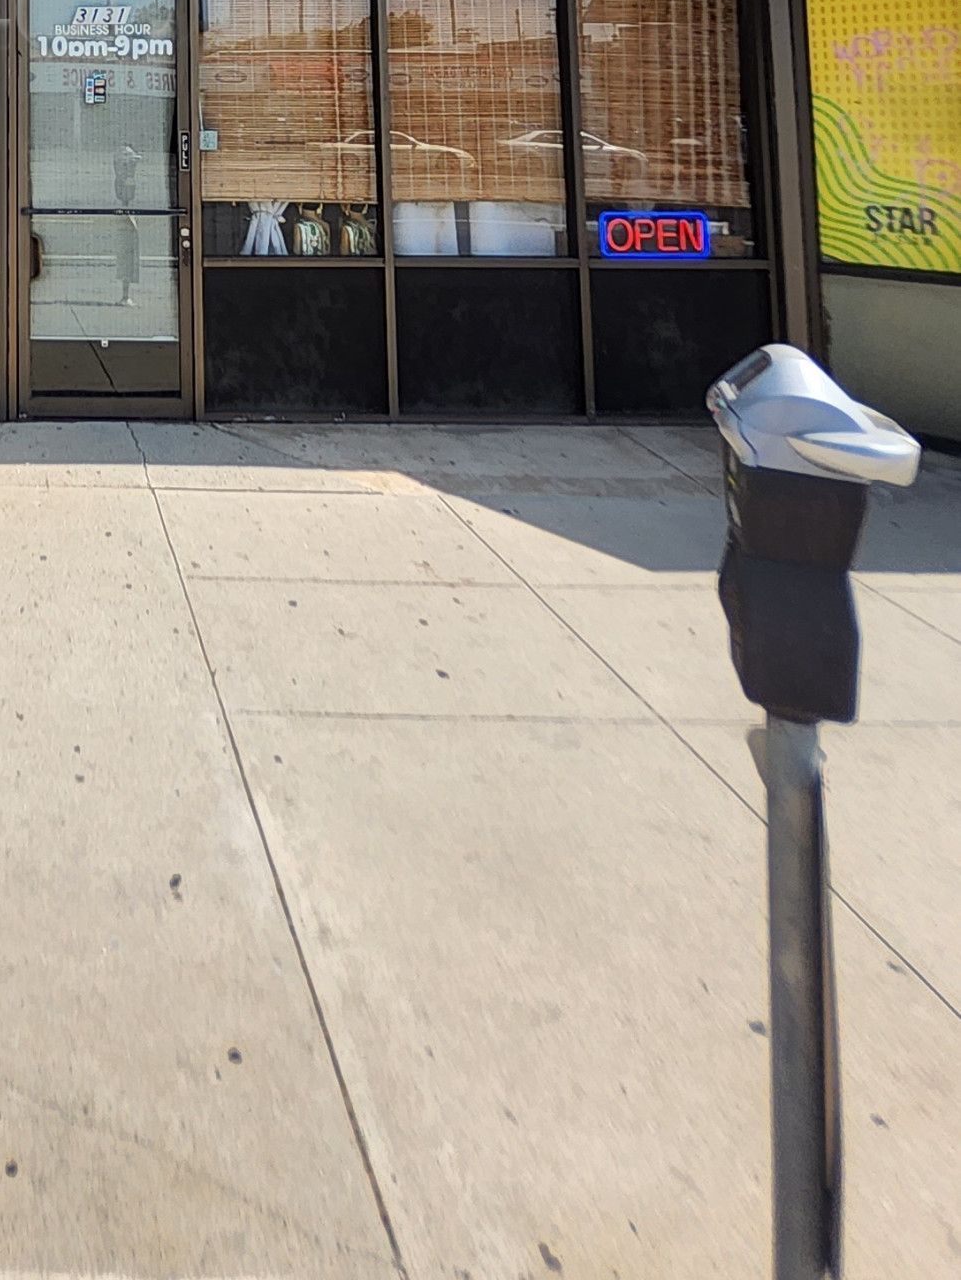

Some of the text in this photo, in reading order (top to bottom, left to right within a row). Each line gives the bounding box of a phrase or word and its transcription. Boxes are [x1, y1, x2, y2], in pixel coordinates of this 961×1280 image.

[76, 7, 125, 23] 3131
[55, 24, 151, 36] BUSINESS HOUR
[863, 205, 939, 237] STAR
[606, 217, 705, 252] OPEN
